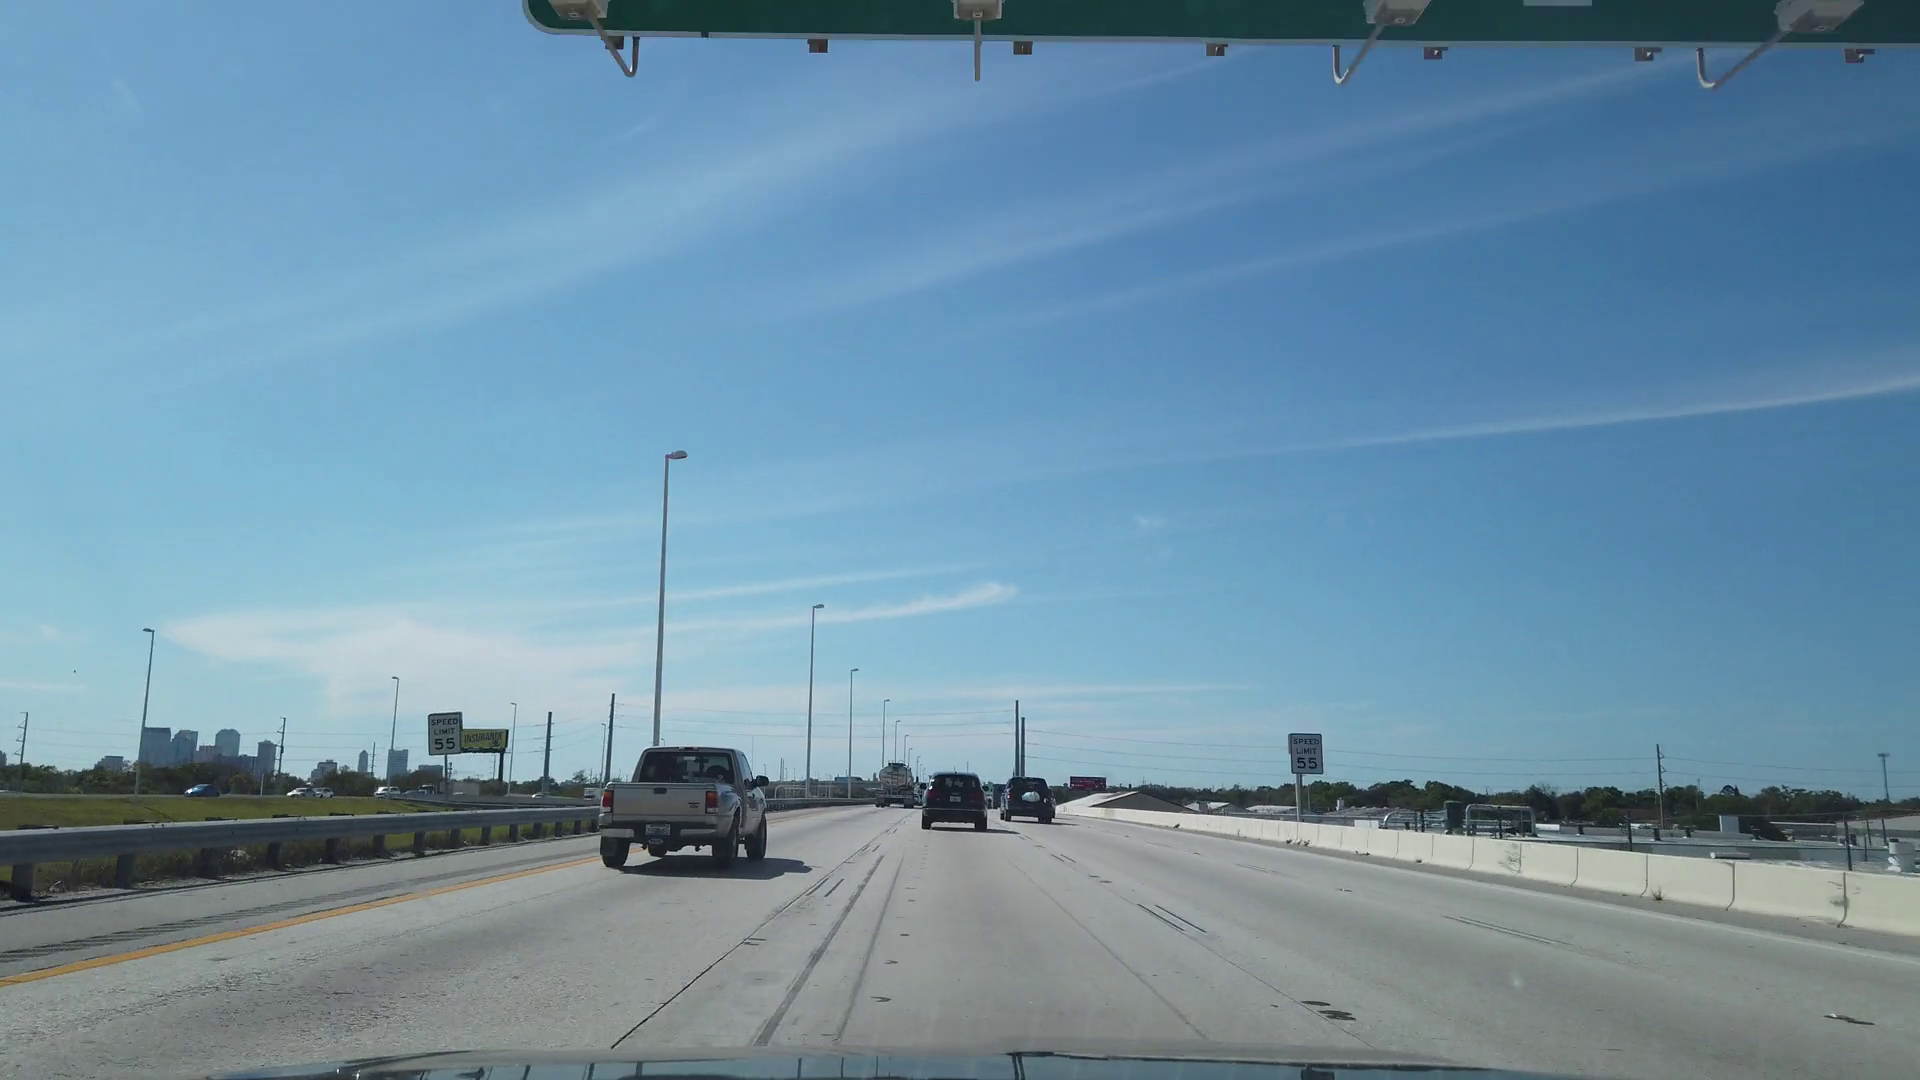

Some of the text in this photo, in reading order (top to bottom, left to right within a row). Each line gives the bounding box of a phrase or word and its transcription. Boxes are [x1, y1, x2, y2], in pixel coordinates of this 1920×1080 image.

[431, 717, 459, 726] SPEED
[434, 727, 456, 736] LIMIT
[434, 737, 456, 751] 55
[1296, 747, 1317, 755] LIMIT
[1296, 757, 1318, 769] 55
